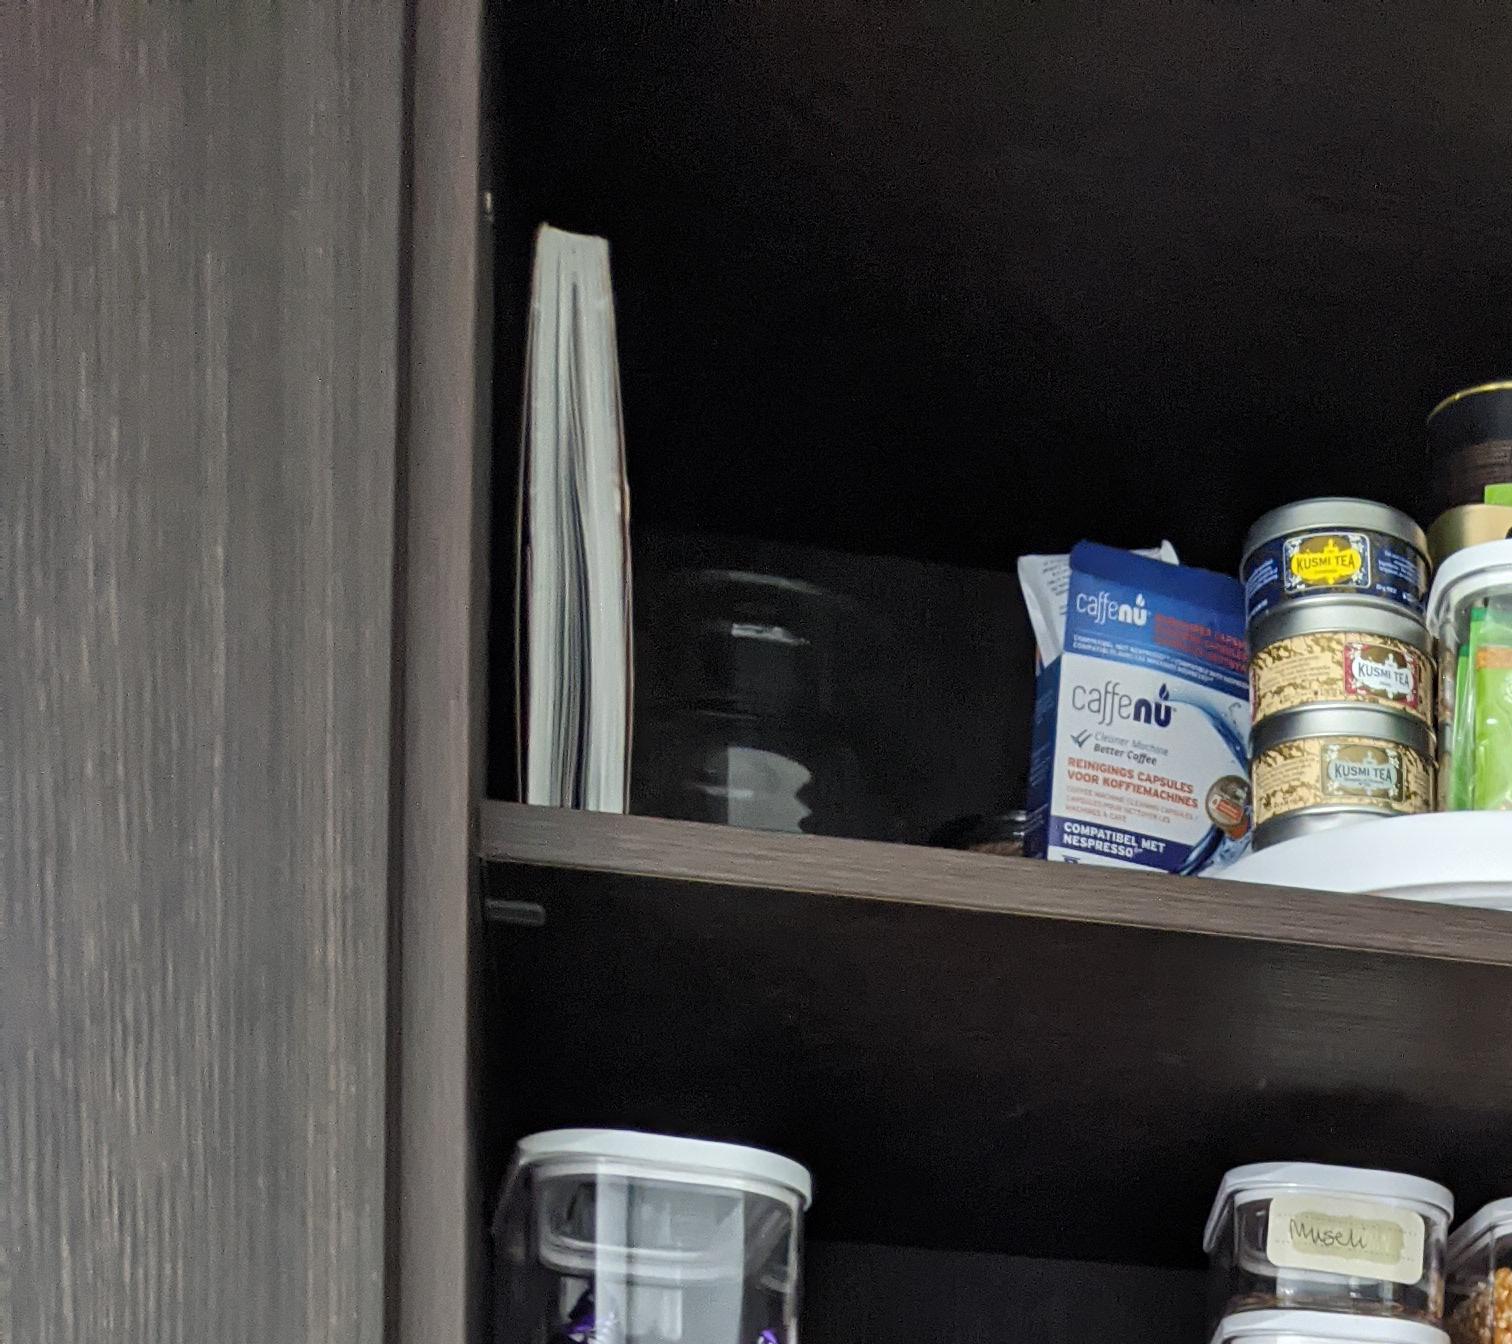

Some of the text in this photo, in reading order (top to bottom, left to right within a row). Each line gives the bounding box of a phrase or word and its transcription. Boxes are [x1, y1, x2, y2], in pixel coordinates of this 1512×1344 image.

[1296, 555, 1332, 571] KUSMI
[1334, 554, 1356, 569] TEA
[1357, 660, 1411, 688] KUSMI TEA
[1093, 744, 1158, 767] Better Coffee
[1067, 757, 1194, 795] REINIGINGS CAPSULES
[1333, 761, 1393, 783] KUSMI TEA
[1067, 770, 1199, 810] VOOR KOFFIEMACHINES
[1063, 820, 1167, 854] COMPATIBEL MET
